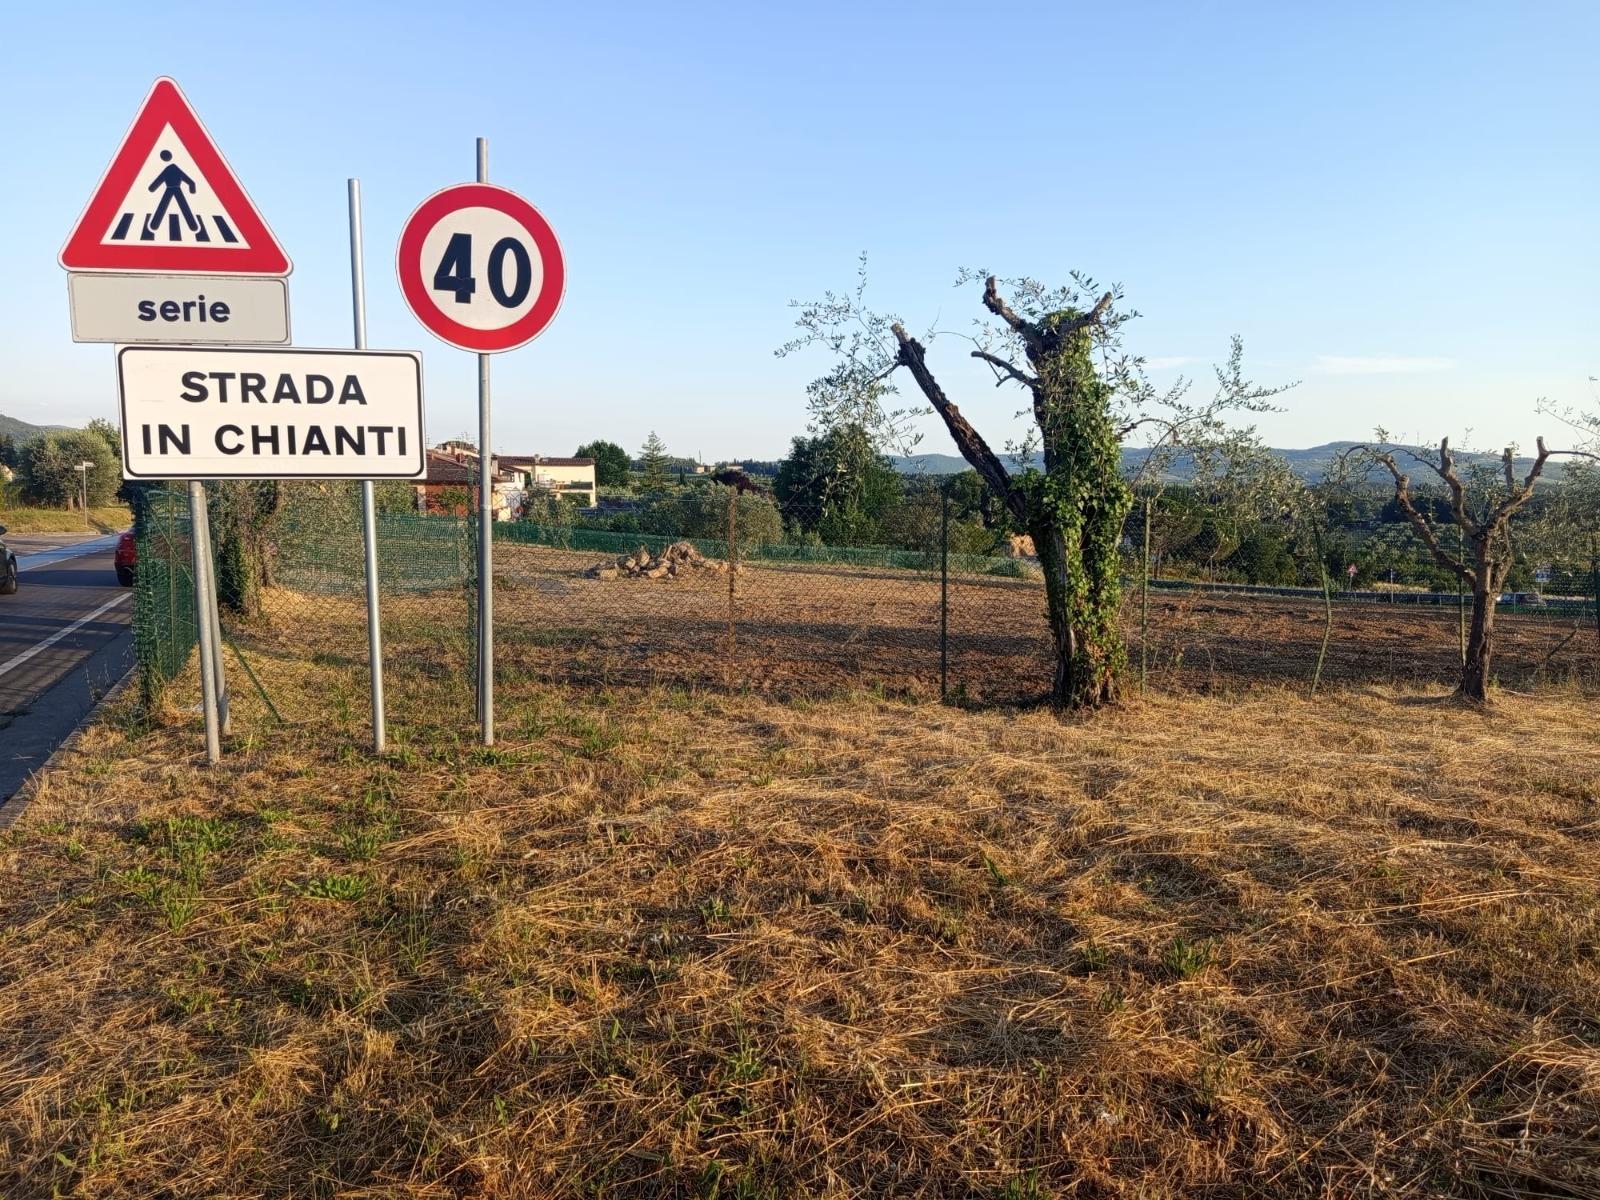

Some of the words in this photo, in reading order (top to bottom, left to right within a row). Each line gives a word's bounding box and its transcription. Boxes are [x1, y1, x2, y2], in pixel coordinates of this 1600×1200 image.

[433, 232, 532, 309] 40
[137, 294, 231, 323] serie
[180, 371, 368, 405] STRADA
[142, 424, 191, 455] IN
[214, 424, 407, 456] CHIANTI
